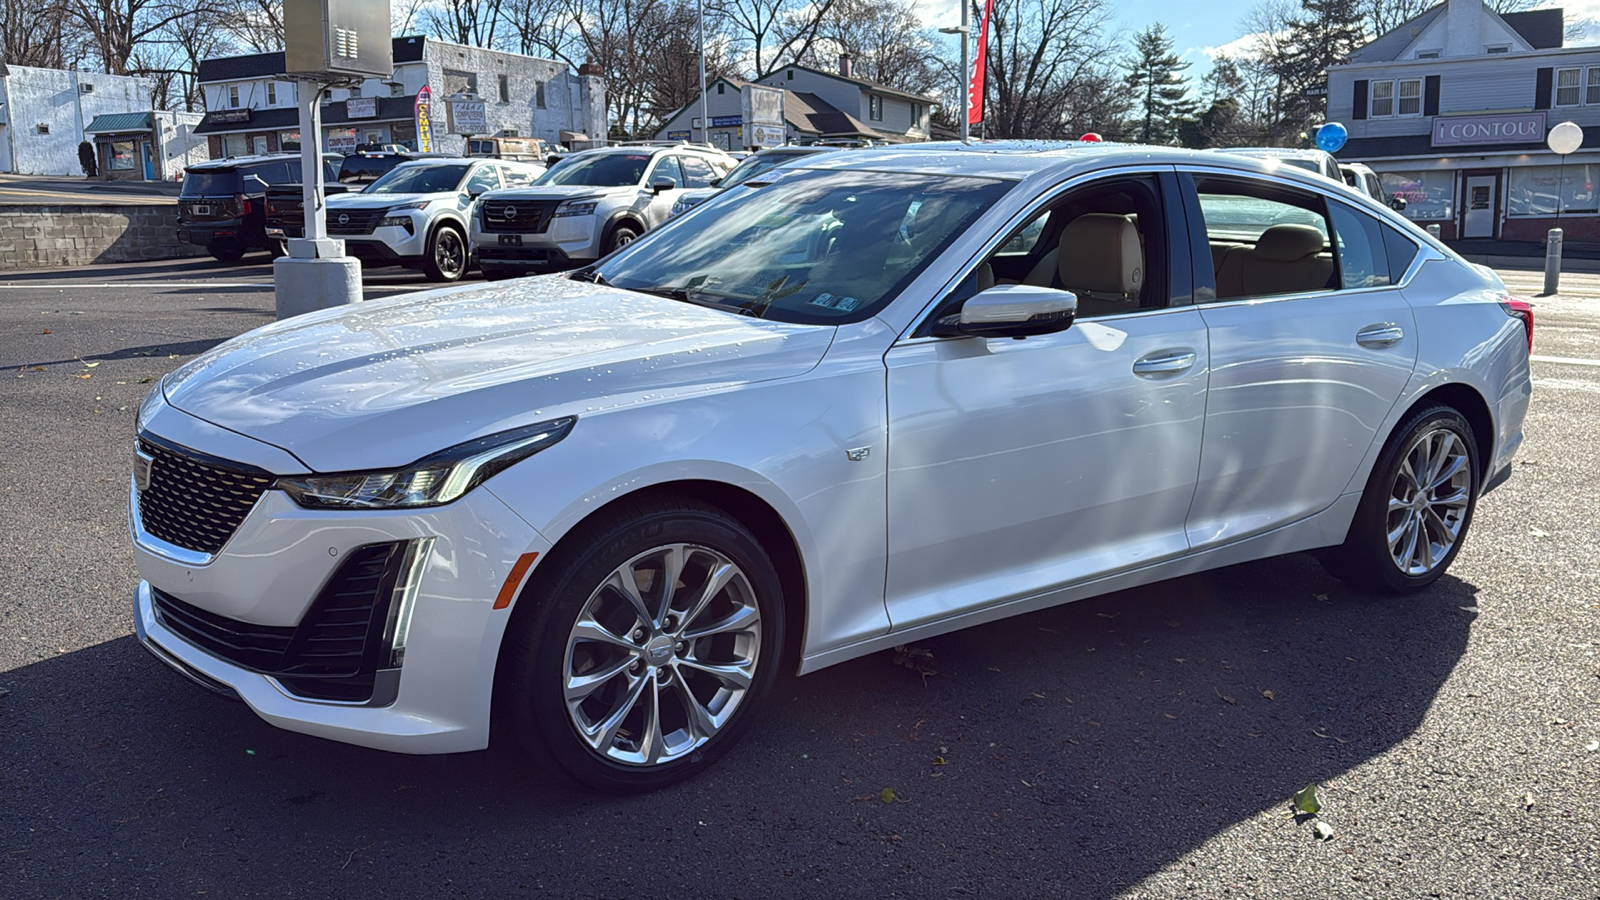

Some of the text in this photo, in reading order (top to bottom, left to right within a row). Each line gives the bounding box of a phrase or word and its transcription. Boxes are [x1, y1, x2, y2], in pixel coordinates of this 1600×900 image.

[455, 111, 484, 119] COMPUTERS
[1450, 121, 1537, 138] CONTOUR
[328, 138, 356, 147] COMPUTERS
